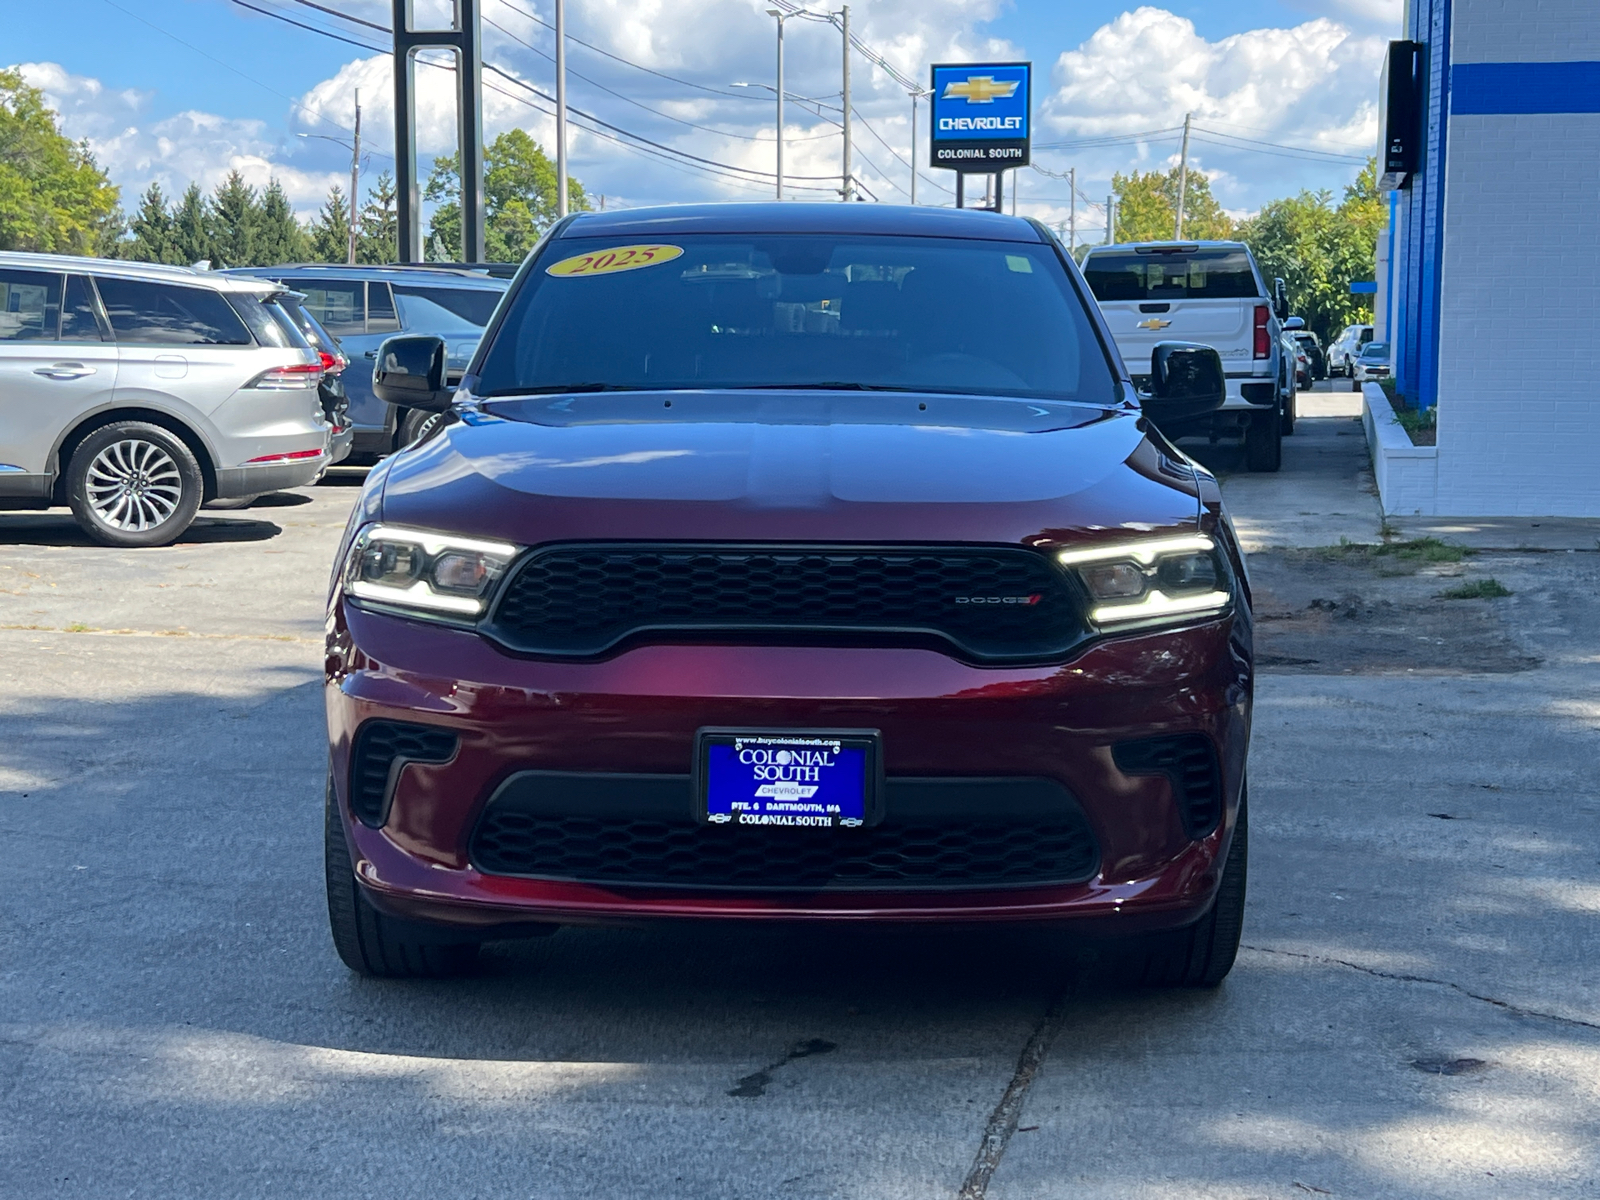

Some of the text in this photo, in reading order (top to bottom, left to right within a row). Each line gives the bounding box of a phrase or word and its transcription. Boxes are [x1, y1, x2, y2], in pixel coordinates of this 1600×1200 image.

[939, 117, 1022, 130] CHEVROLET
[938, 148, 1022, 159] COLONIAL SOUTH
[569, 247, 660, 274] 2025
[955, 596, 1030, 604] DODGE
[735, 737, 841, 747] www.buycolonialsouth.com
[739, 749, 835, 766] COLONIAL
[753, 766, 820, 781] SOUTH
[761, 786, 812, 795] CHEVROLET
[731, 802, 841, 813] RTE. 6 DARTMOUTH, MA
[739, 814, 832, 827] COLONIAL SOUTH
